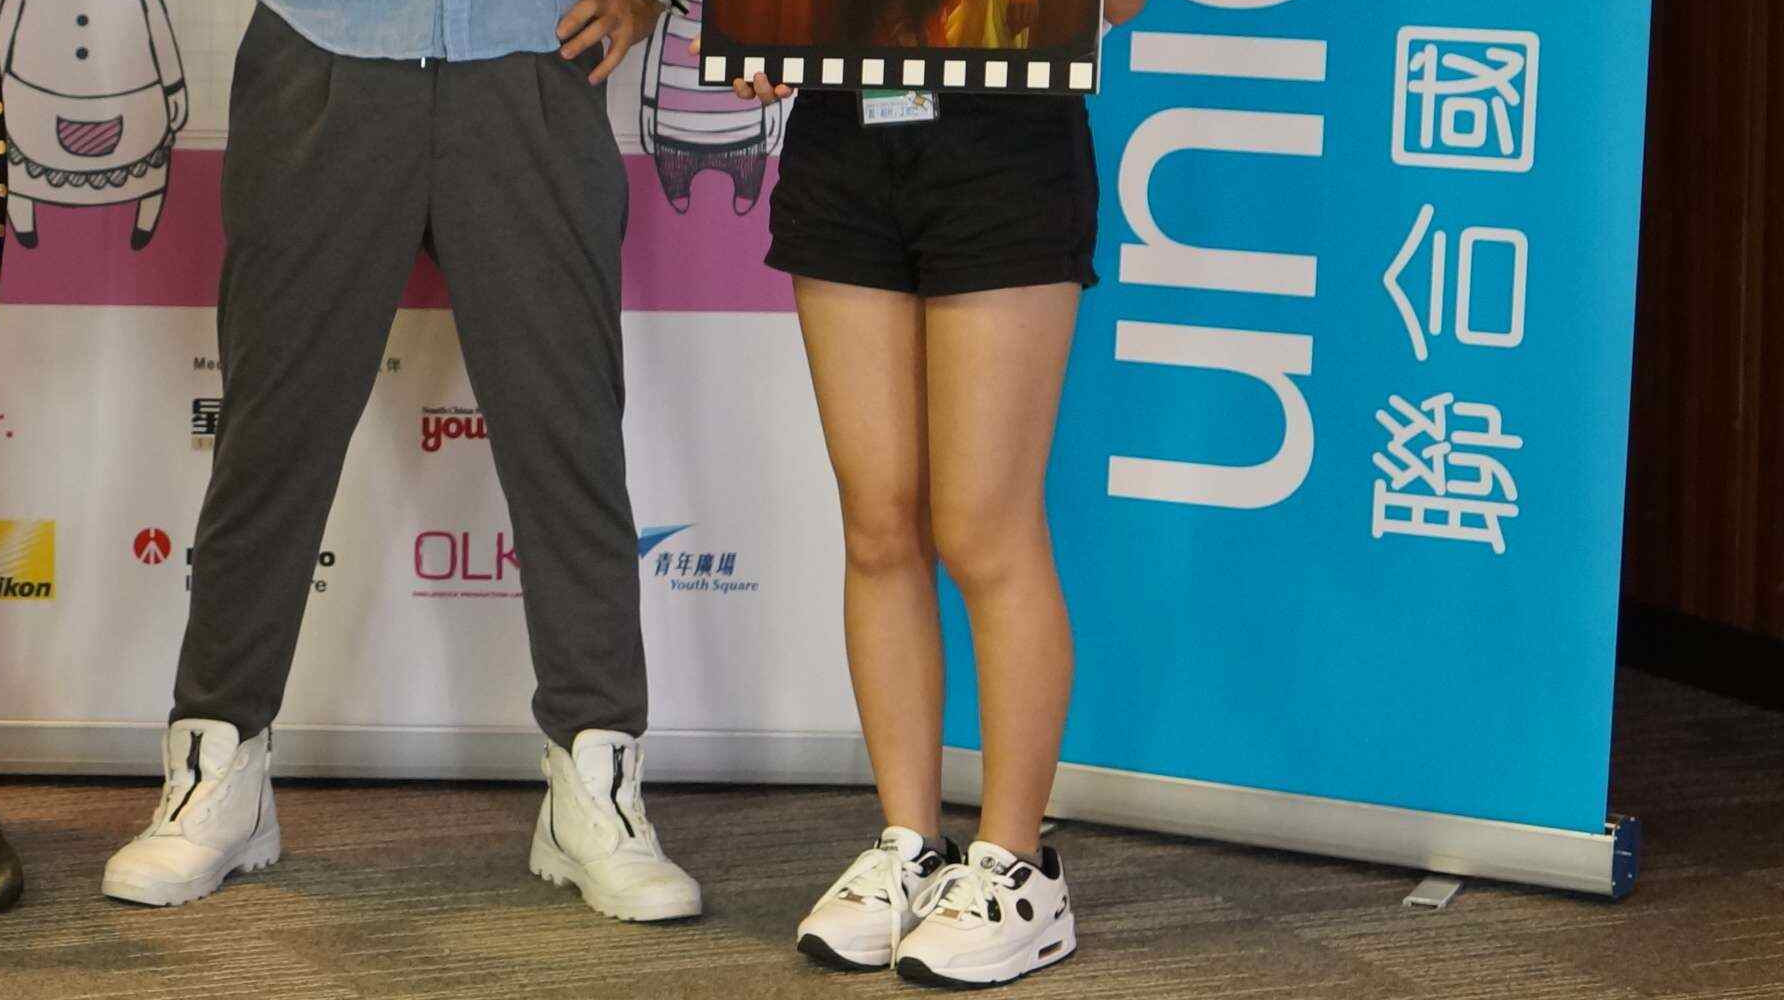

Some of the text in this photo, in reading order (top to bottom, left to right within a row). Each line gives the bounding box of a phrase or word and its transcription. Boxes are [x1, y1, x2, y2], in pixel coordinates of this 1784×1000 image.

[654, 551, 738, 577] 青年廣場
[670, 578, 760, 595] Youth Square
